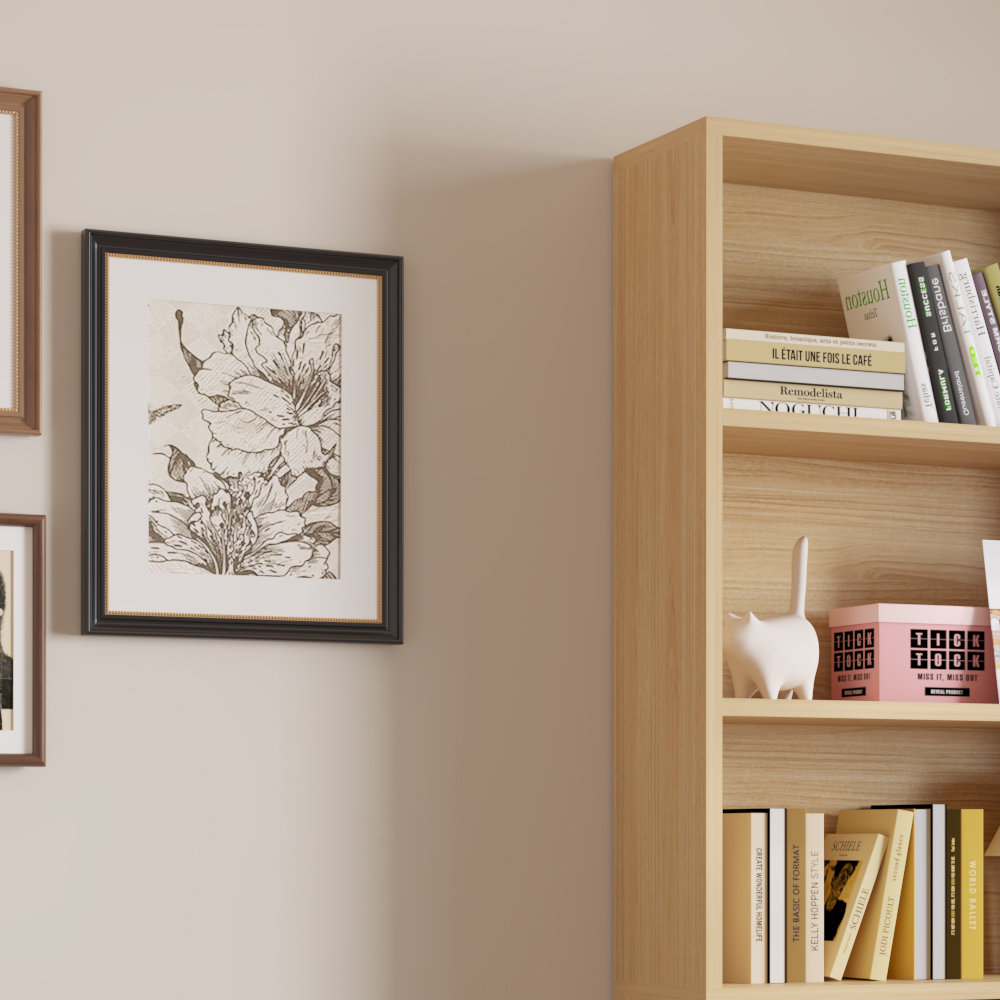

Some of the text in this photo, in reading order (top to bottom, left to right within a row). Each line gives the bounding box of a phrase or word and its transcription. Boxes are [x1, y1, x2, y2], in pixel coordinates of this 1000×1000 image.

[772, 347, 873, 367] IL ÉTAIT UNE FOIS LE CAFÉ
[780, 386, 843, 400] Remodelista
[836, 631, 872, 649] TICK
[915, 632, 980, 648] TICK
[836, 652, 872, 669] TOCK
[915, 652, 980, 668] TOCK
[917, 673, 934, 681] MISS
[946, 673, 964, 682] MISS
[965, 674, 978, 682] OUT
[831, 840, 862, 852] SCHIELE
[755, 847, 763, 943] CREATE WONDERFUL HOMELIFE
[792, 844, 800, 943] THE BASIC OF FORMAT
[810, 850, 819, 952] KELLY HOPPEN STYLE
[968, 860, 977, 930] WORLD BALLET
[850, 887, 870, 931] SCHIELE
[880, 896, 895, 956] JODI PICOULT
